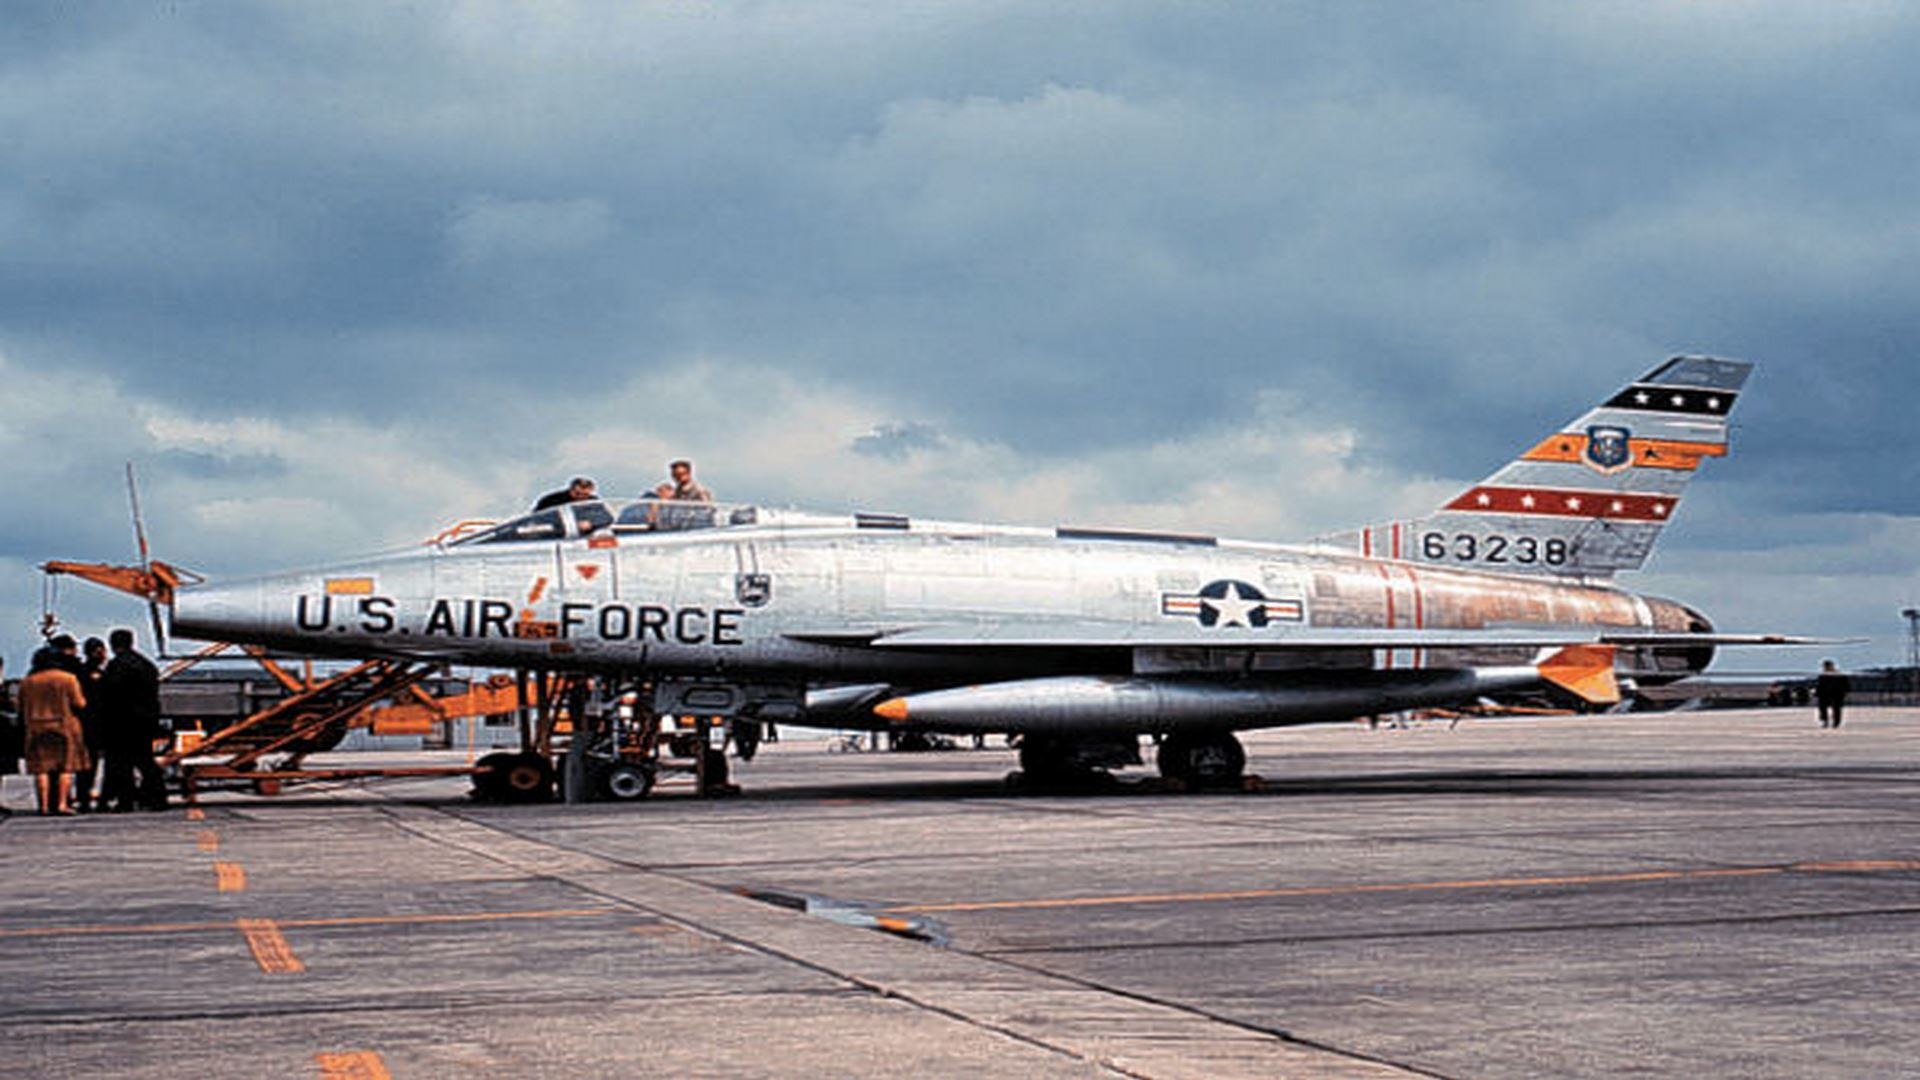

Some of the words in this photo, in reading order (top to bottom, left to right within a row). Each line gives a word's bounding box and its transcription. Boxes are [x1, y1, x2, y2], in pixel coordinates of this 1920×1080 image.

[1423, 532, 1567, 565] 63238
[297, 595, 409, 635] U.S.
[425, 599, 513, 638] AIR
[561, 603, 744, 645] FORCE
